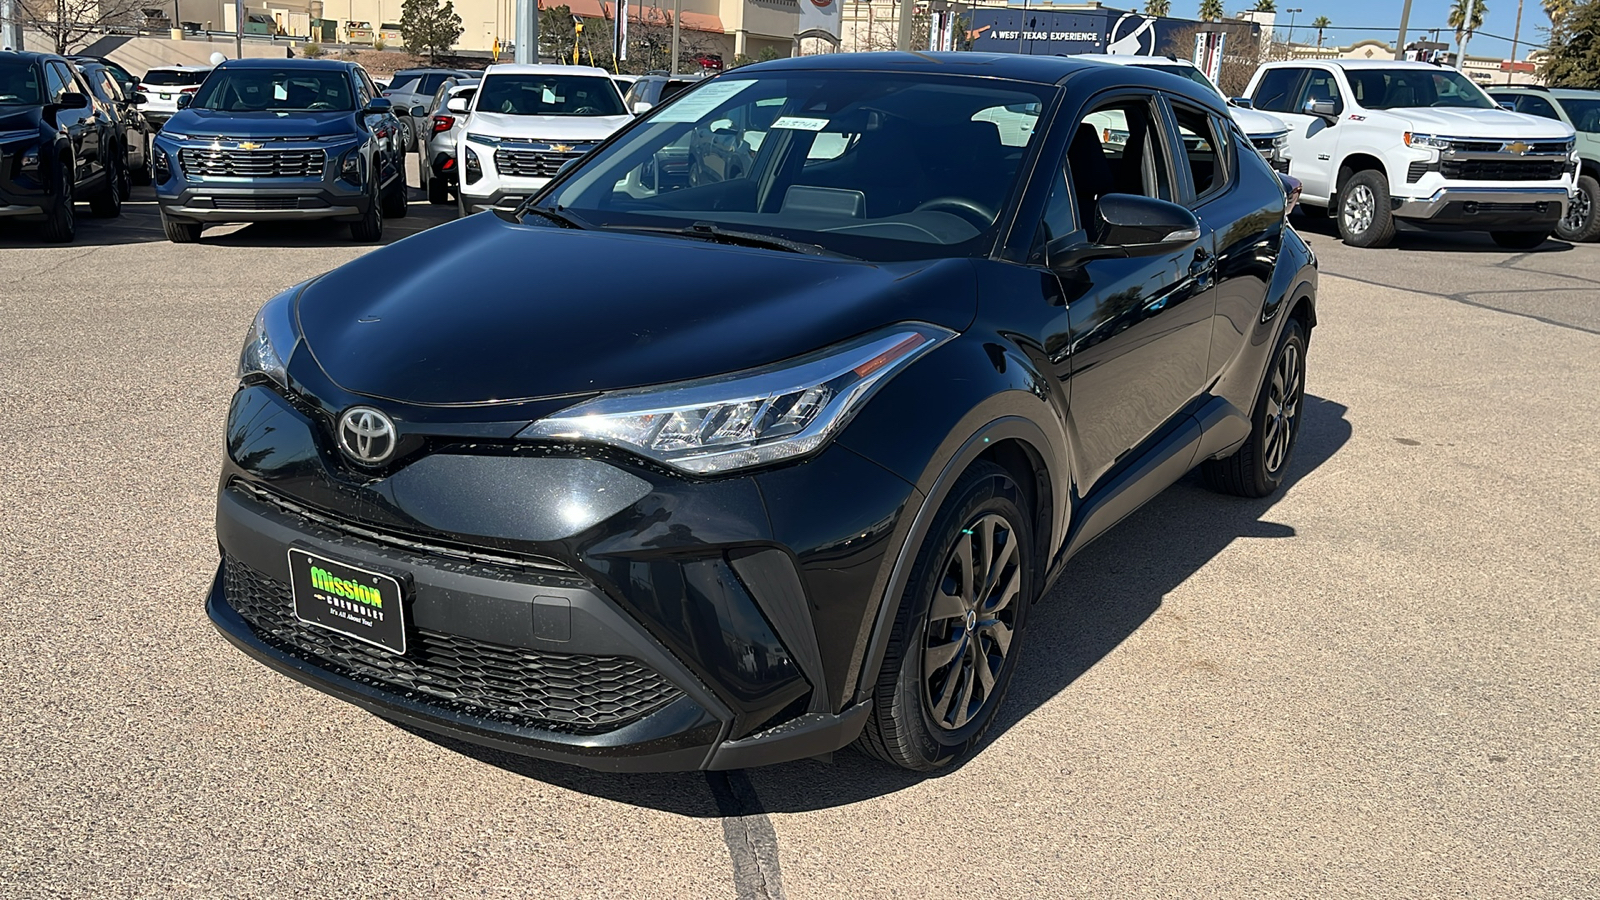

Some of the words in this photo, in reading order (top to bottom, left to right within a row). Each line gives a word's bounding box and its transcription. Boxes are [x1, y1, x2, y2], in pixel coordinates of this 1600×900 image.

[990, 31, 997, 39] A
[999, 31, 1019, 39] WEST
[1023, 32, 1048, 40] TEXAS
[311, 566, 382, 608] Mission
[327, 595, 383, 621] CHEVROLET
[347, 614, 361, 623] About
